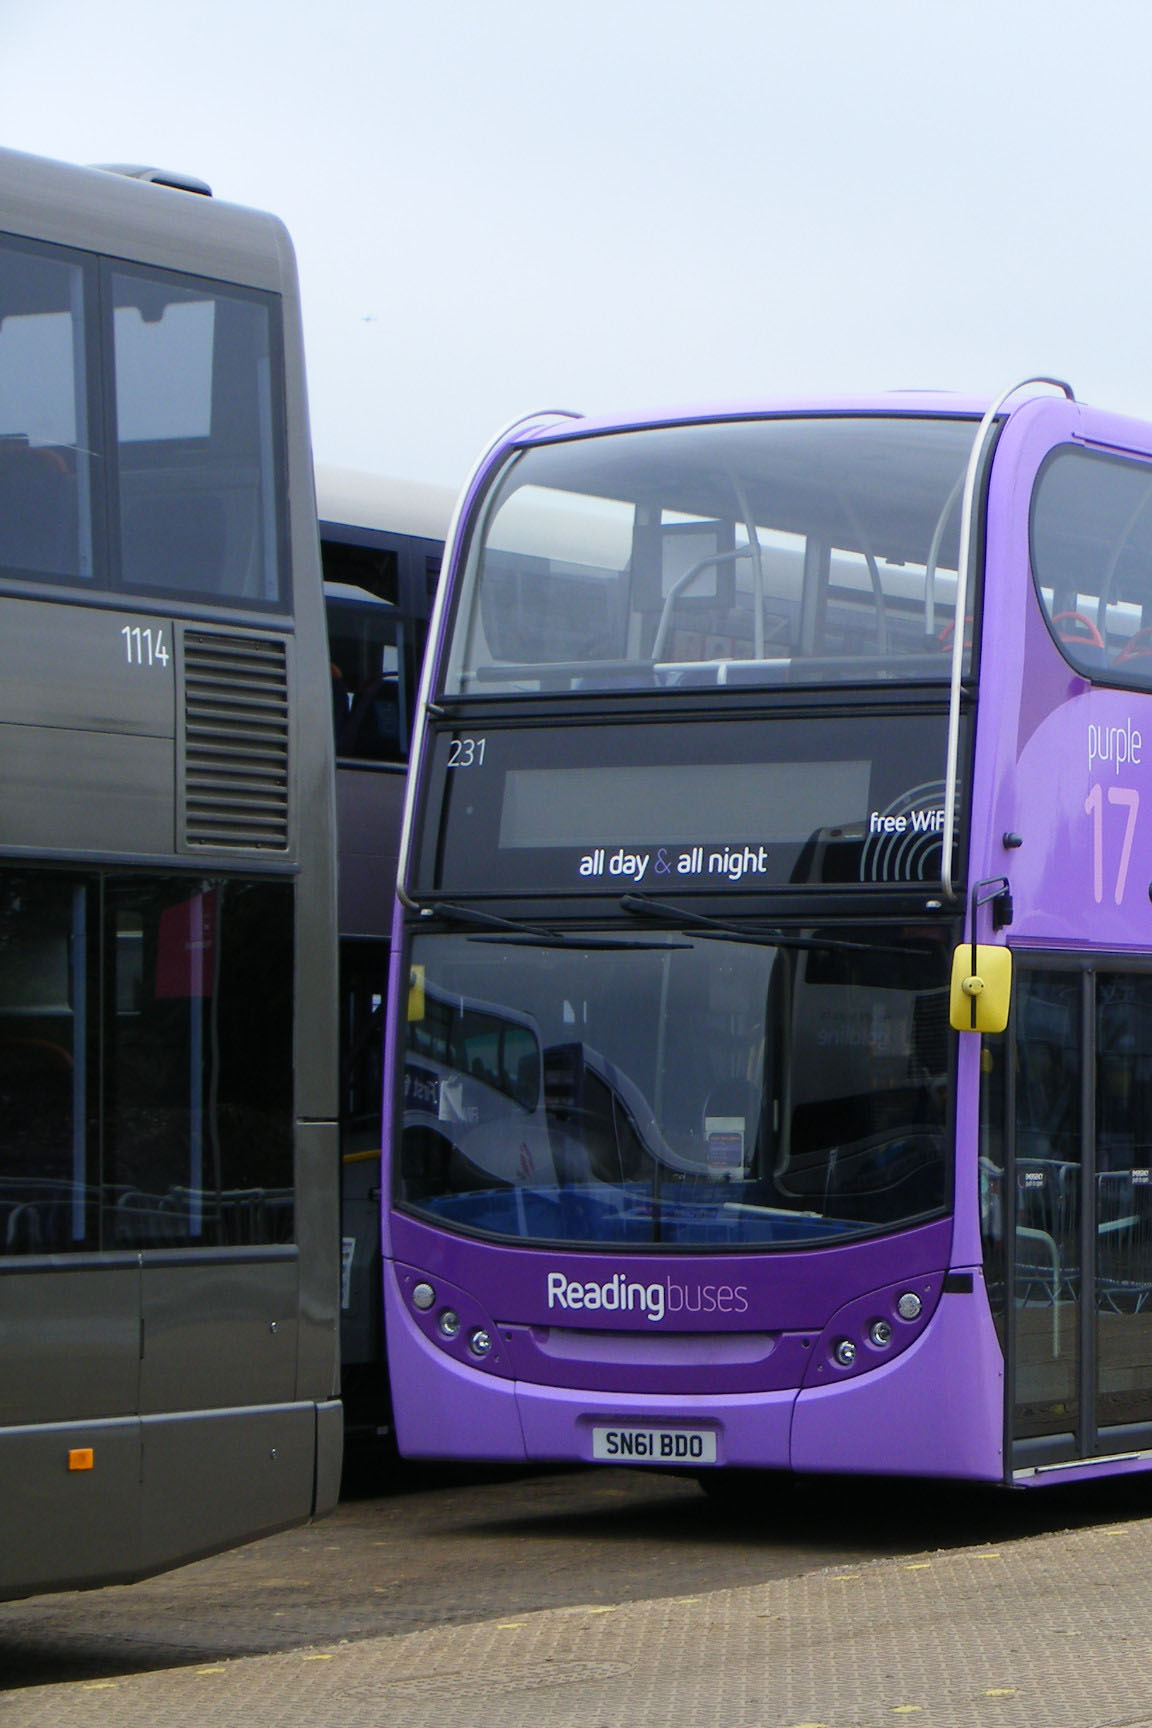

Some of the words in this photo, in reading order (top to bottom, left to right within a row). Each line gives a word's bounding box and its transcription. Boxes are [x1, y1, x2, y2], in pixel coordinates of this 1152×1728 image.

[121, 625, 169, 667] 1114
[448, 739, 486, 767] 231
[1088, 717, 1142, 775] purple
[870, 811, 907, 833] free
[911, 810, 946, 832] WiF
[1084, 783, 1140, 905] 17
[580, 849, 605, 876] all
[609, 849, 650, 882] day
[654, 848, 671, 874] &
[677, 847, 703, 874] all
[709, 846, 768, 880] night
[606, 1432, 653, 1456] SN61
[660, 1434, 703, 1458] BDO
